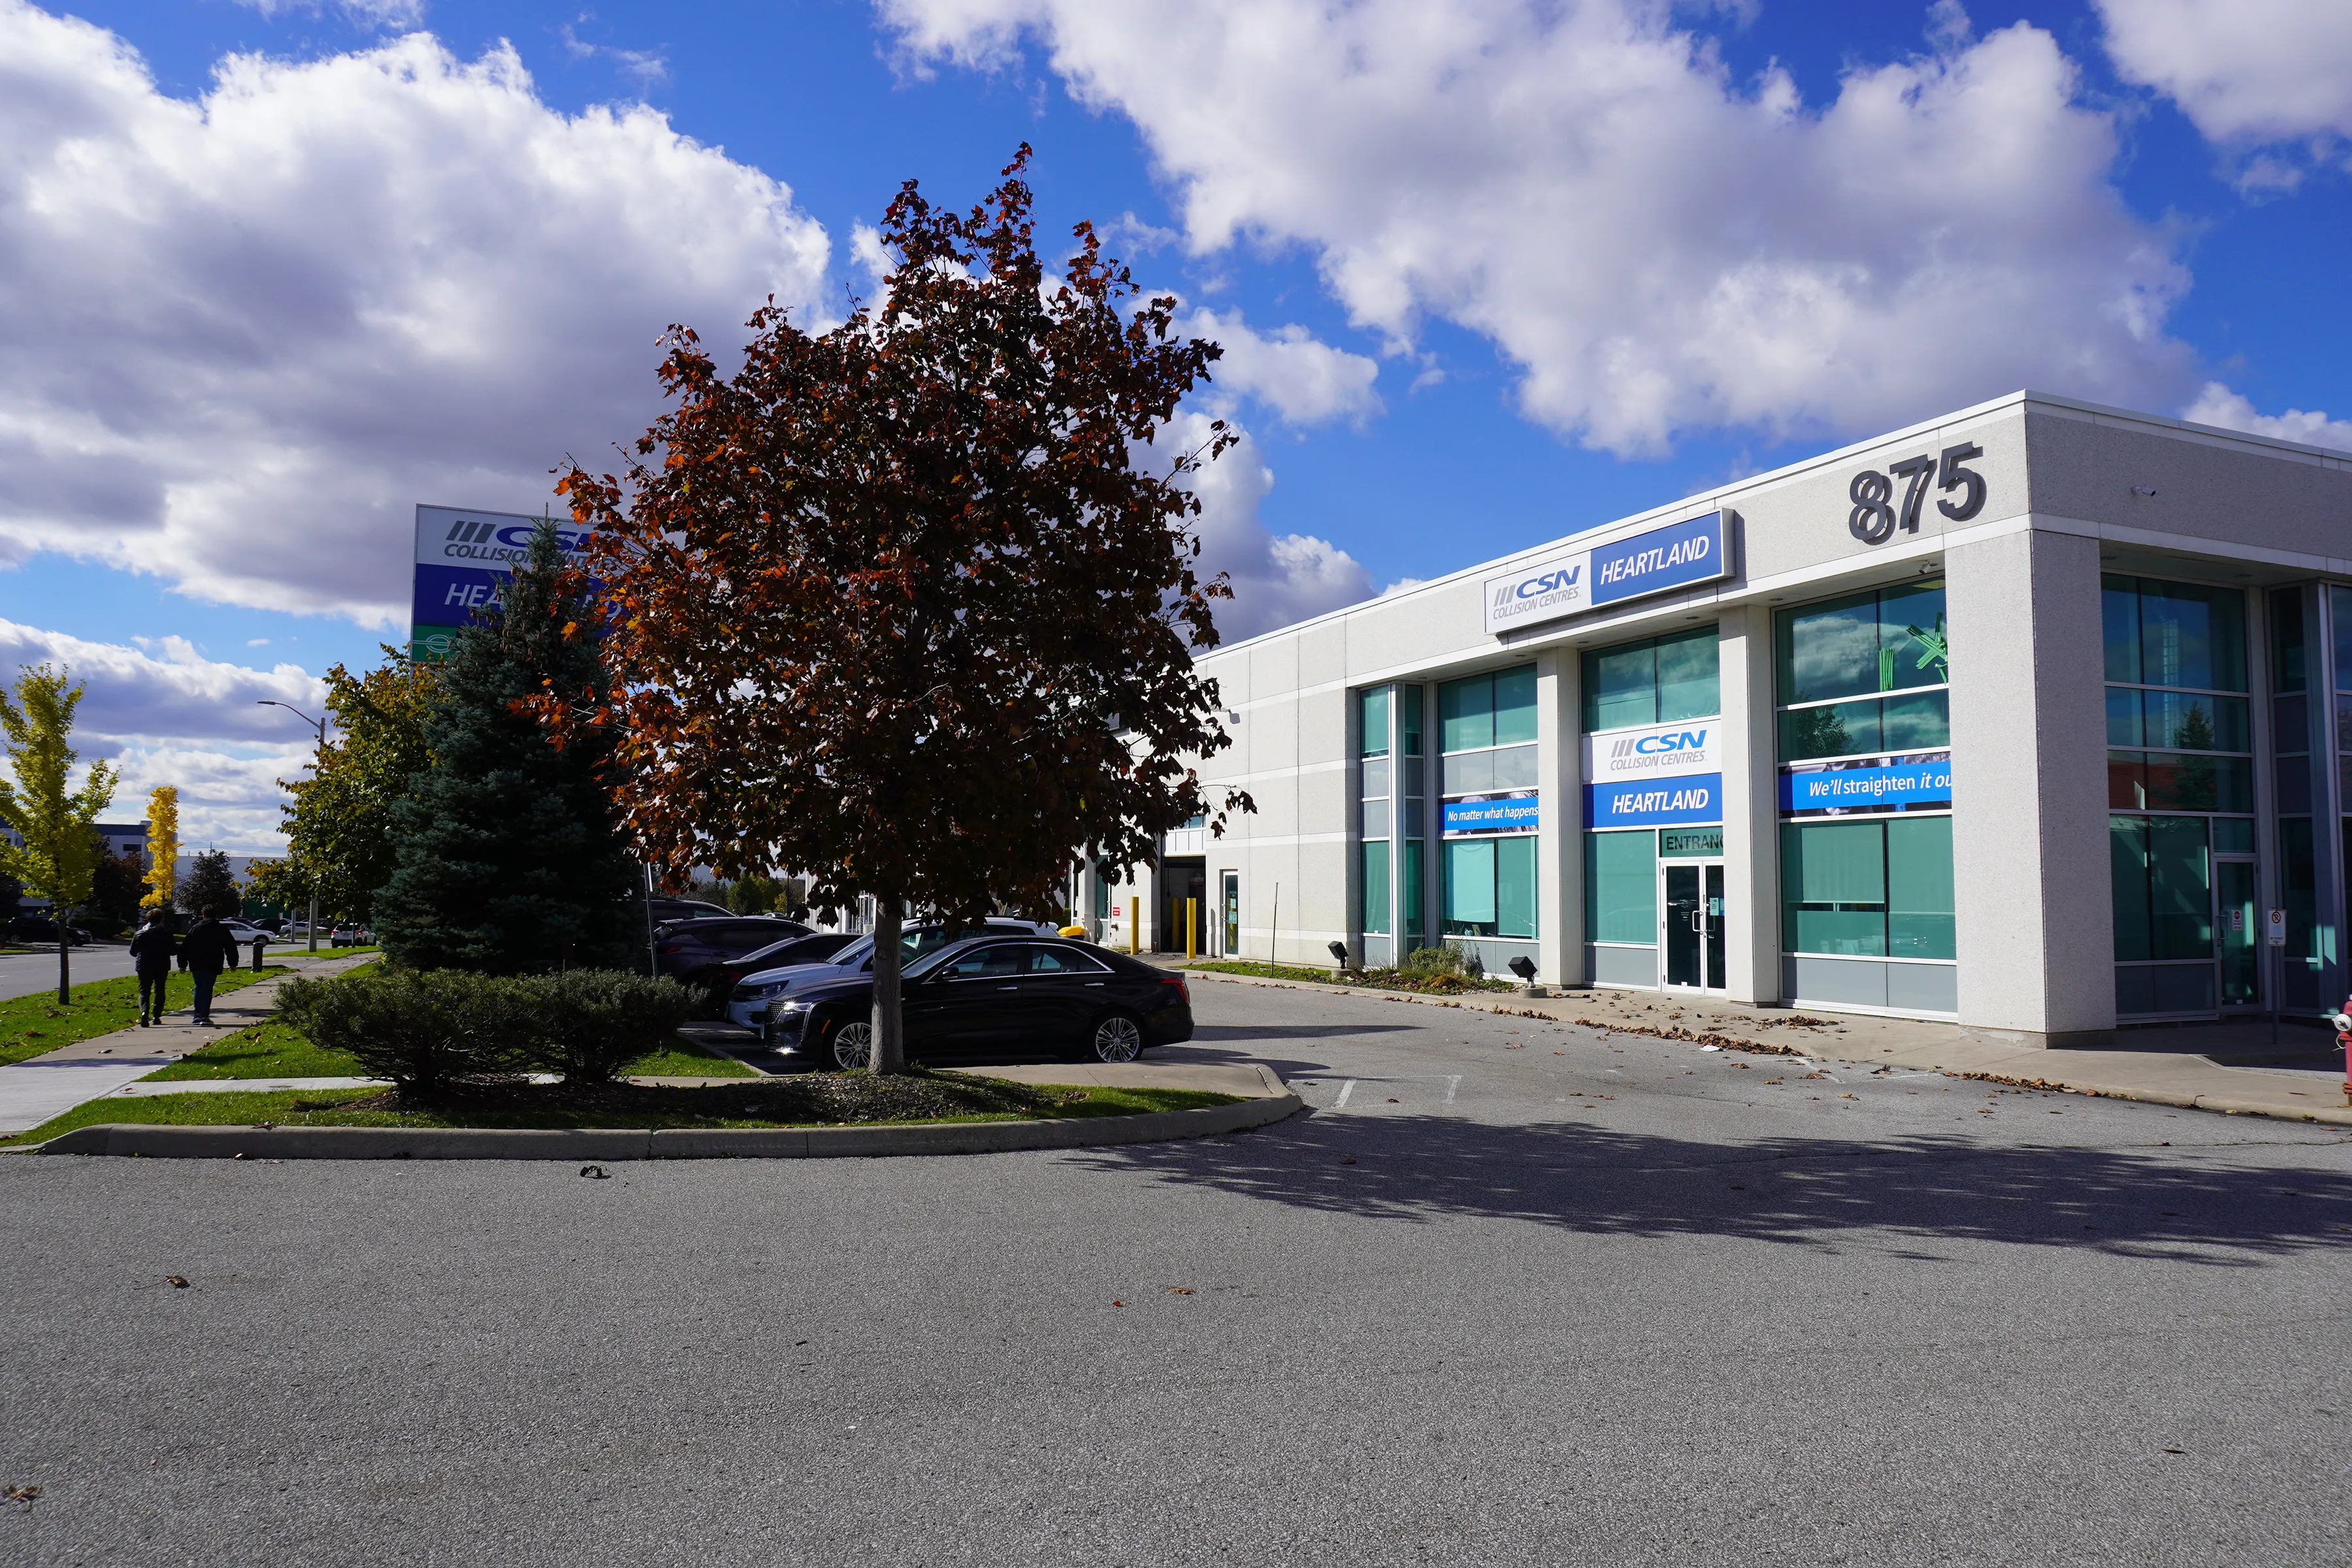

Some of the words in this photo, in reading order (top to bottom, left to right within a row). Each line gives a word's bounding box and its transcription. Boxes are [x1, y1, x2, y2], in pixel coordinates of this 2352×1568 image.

[1849, 441, 1979, 541] 875
[1600, 535, 1710, 585] HEARTLAND
[1516, 564, 1581, 599] CSN
[1493, 598, 1538, 620] COLLISION
[1539, 586, 1580, 608] CENTRES
[1635, 729, 1707, 754] CSN
[1610, 755, 1659, 771] COLLISION
[1661, 750, 1706, 766] CENTRES
[1809, 778, 1842, 796] We’ll
[1843, 775, 1916, 796] straighten
[1919, 772, 1933, 789] it
[1612, 789, 1709, 814] HEARTLAND
[1448, 811, 1458, 822] No
[1459, 809, 1484, 821] matter
[1484, 807, 1503, 819] what
